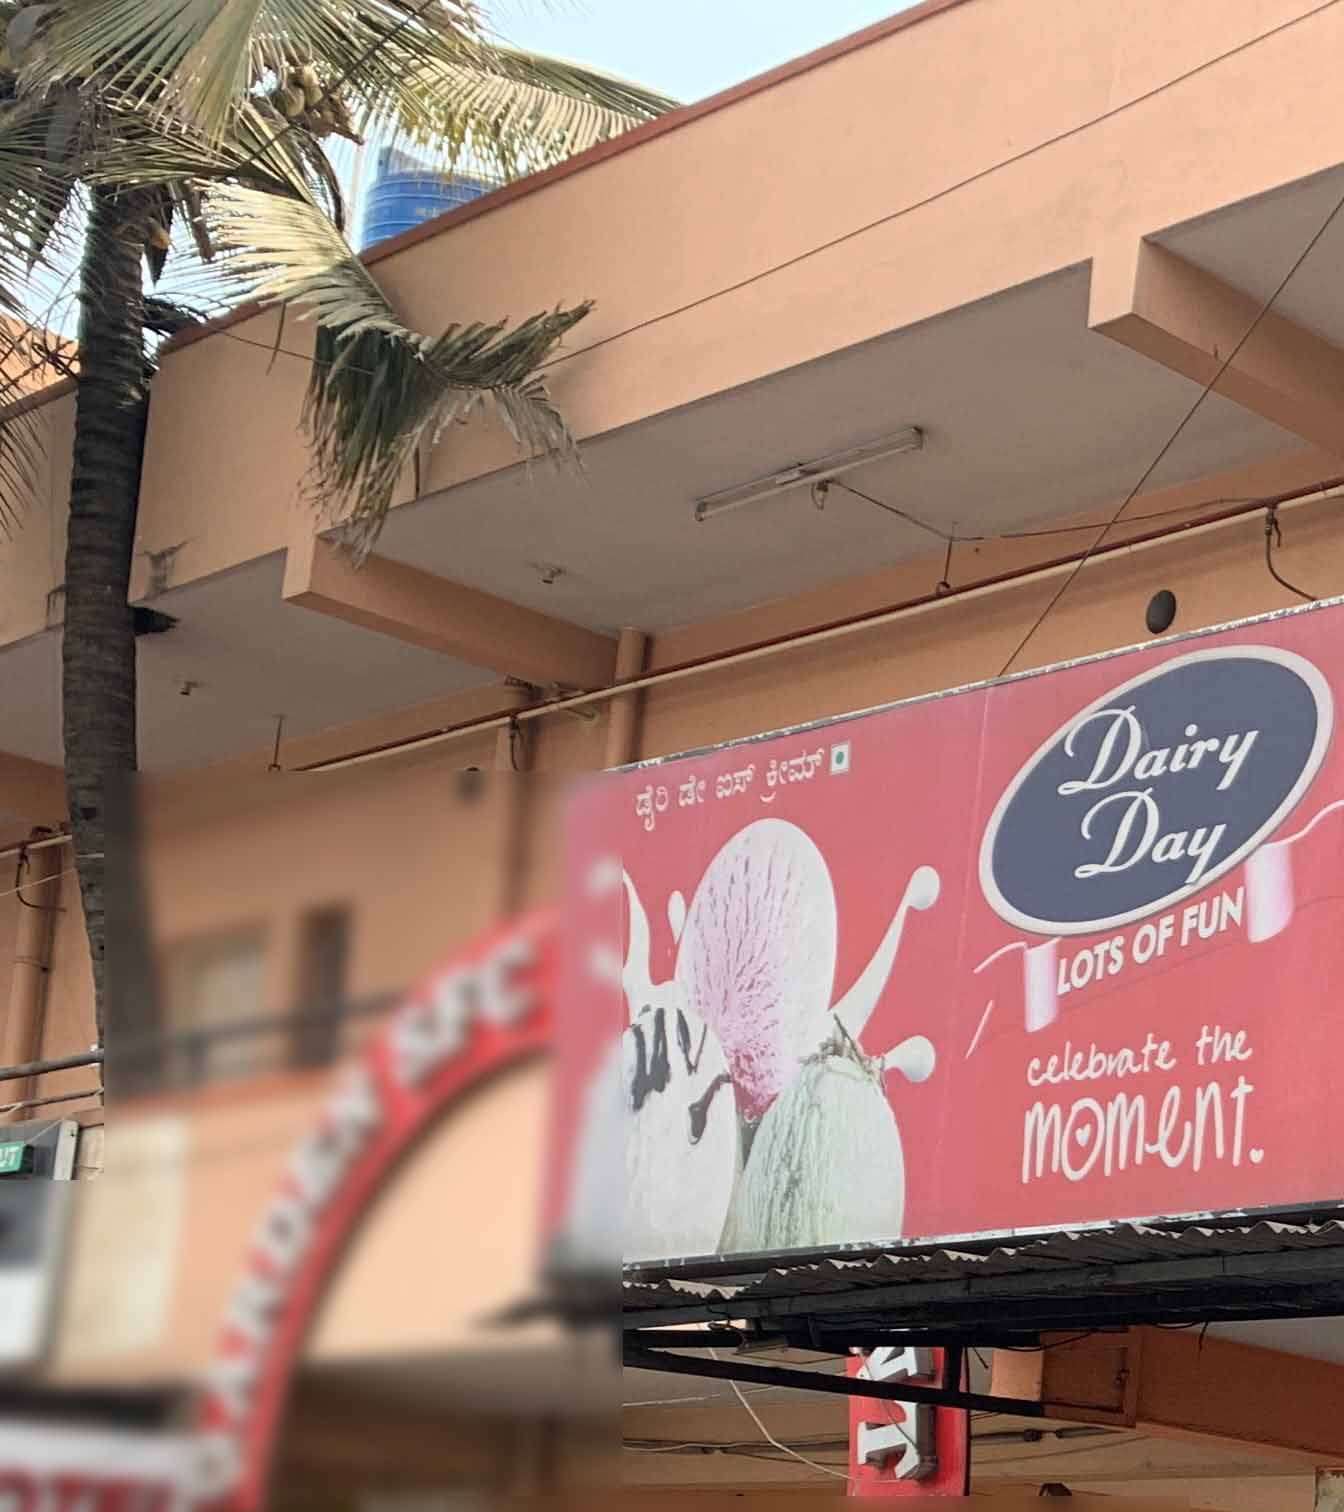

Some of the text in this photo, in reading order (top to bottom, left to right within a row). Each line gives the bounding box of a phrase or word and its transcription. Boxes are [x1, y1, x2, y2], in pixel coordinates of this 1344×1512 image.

[1058, 704, 1260, 796] Dairy
[636, 785, 669, 831] ಡೈರಿ
[1074, 788, 1228, 886] Day
[1055, 886, 1245, 997] LOTS OF FUN
[1026, 1024, 1253, 1089] celebrate the
